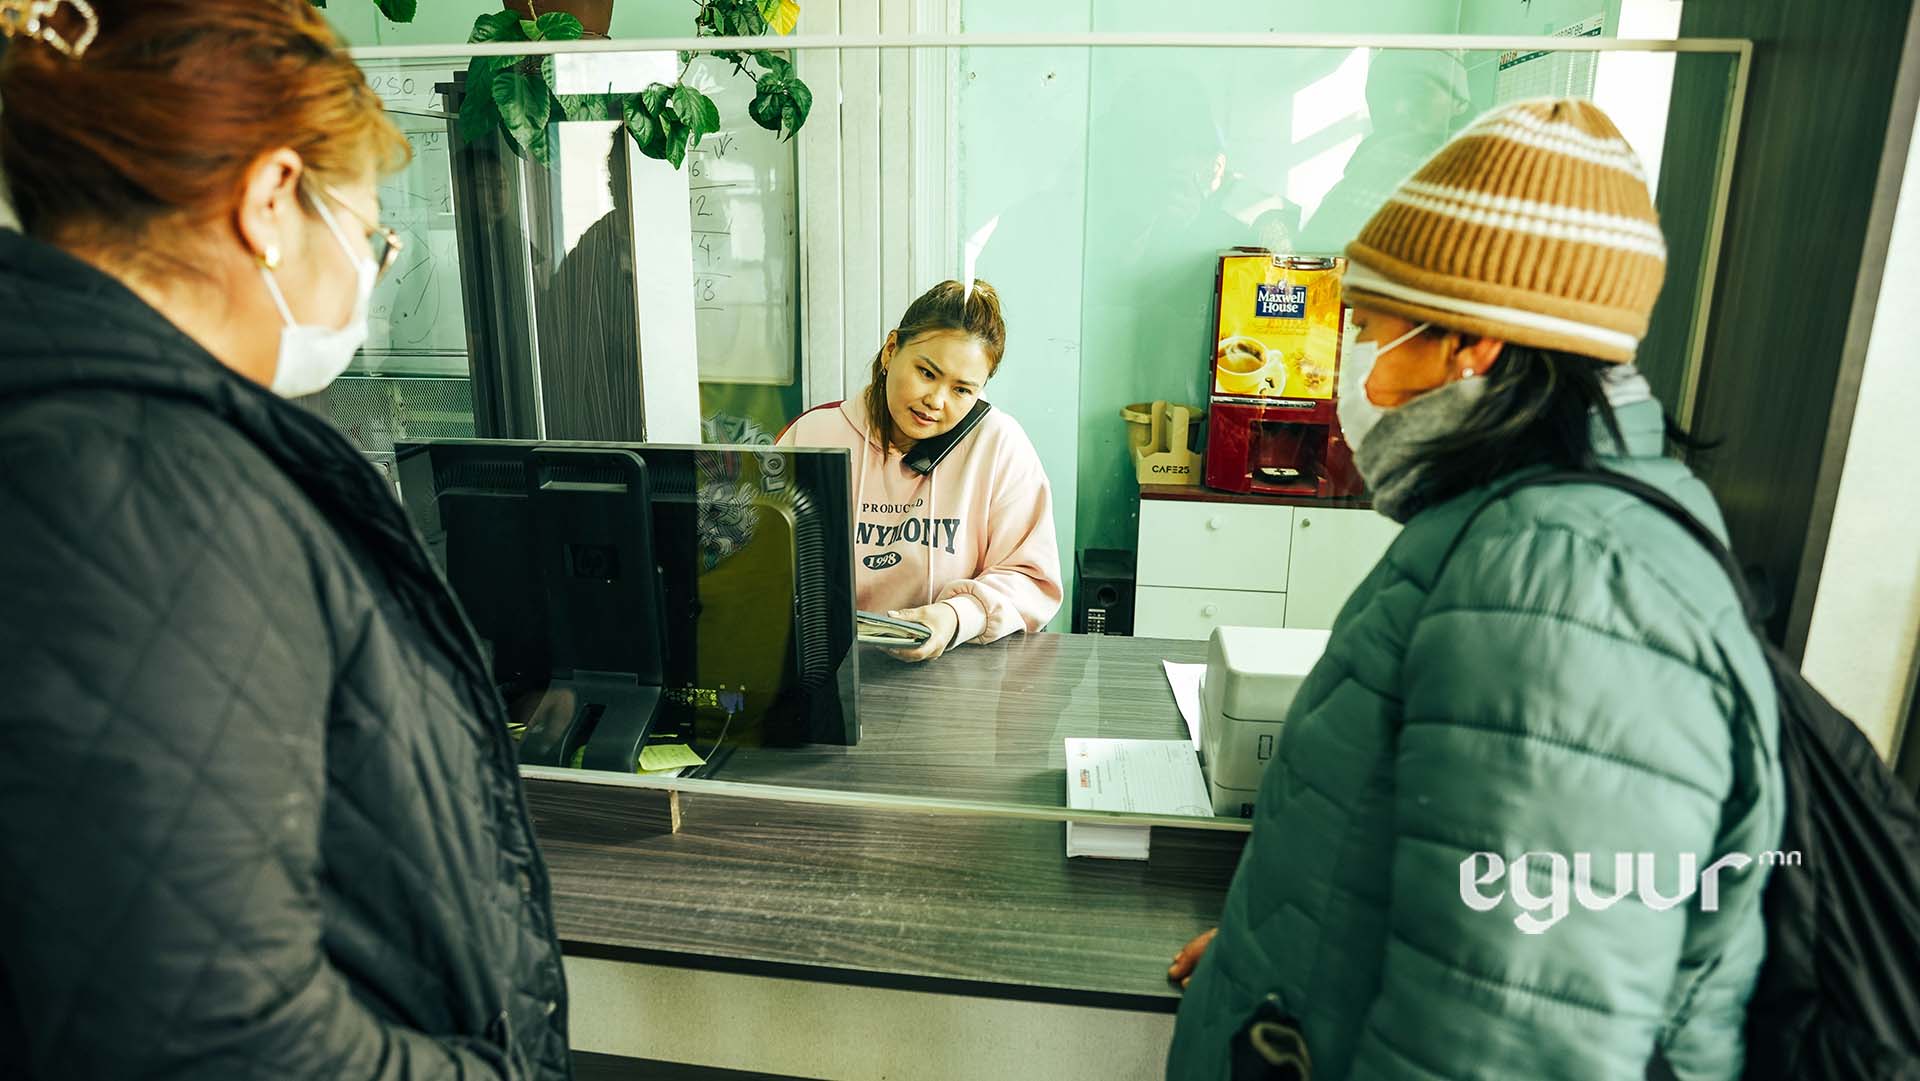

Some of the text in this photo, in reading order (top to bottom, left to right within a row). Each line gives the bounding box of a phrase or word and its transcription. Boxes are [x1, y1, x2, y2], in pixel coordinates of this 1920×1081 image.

[1257, 290, 1305, 304] Maxwell
[1262, 301, 1299, 313] House
[1152, 465, 1190, 474] CAFE25
[862, 498, 923, 513] PRODUCD
[868, 553, 897, 568] 1998
